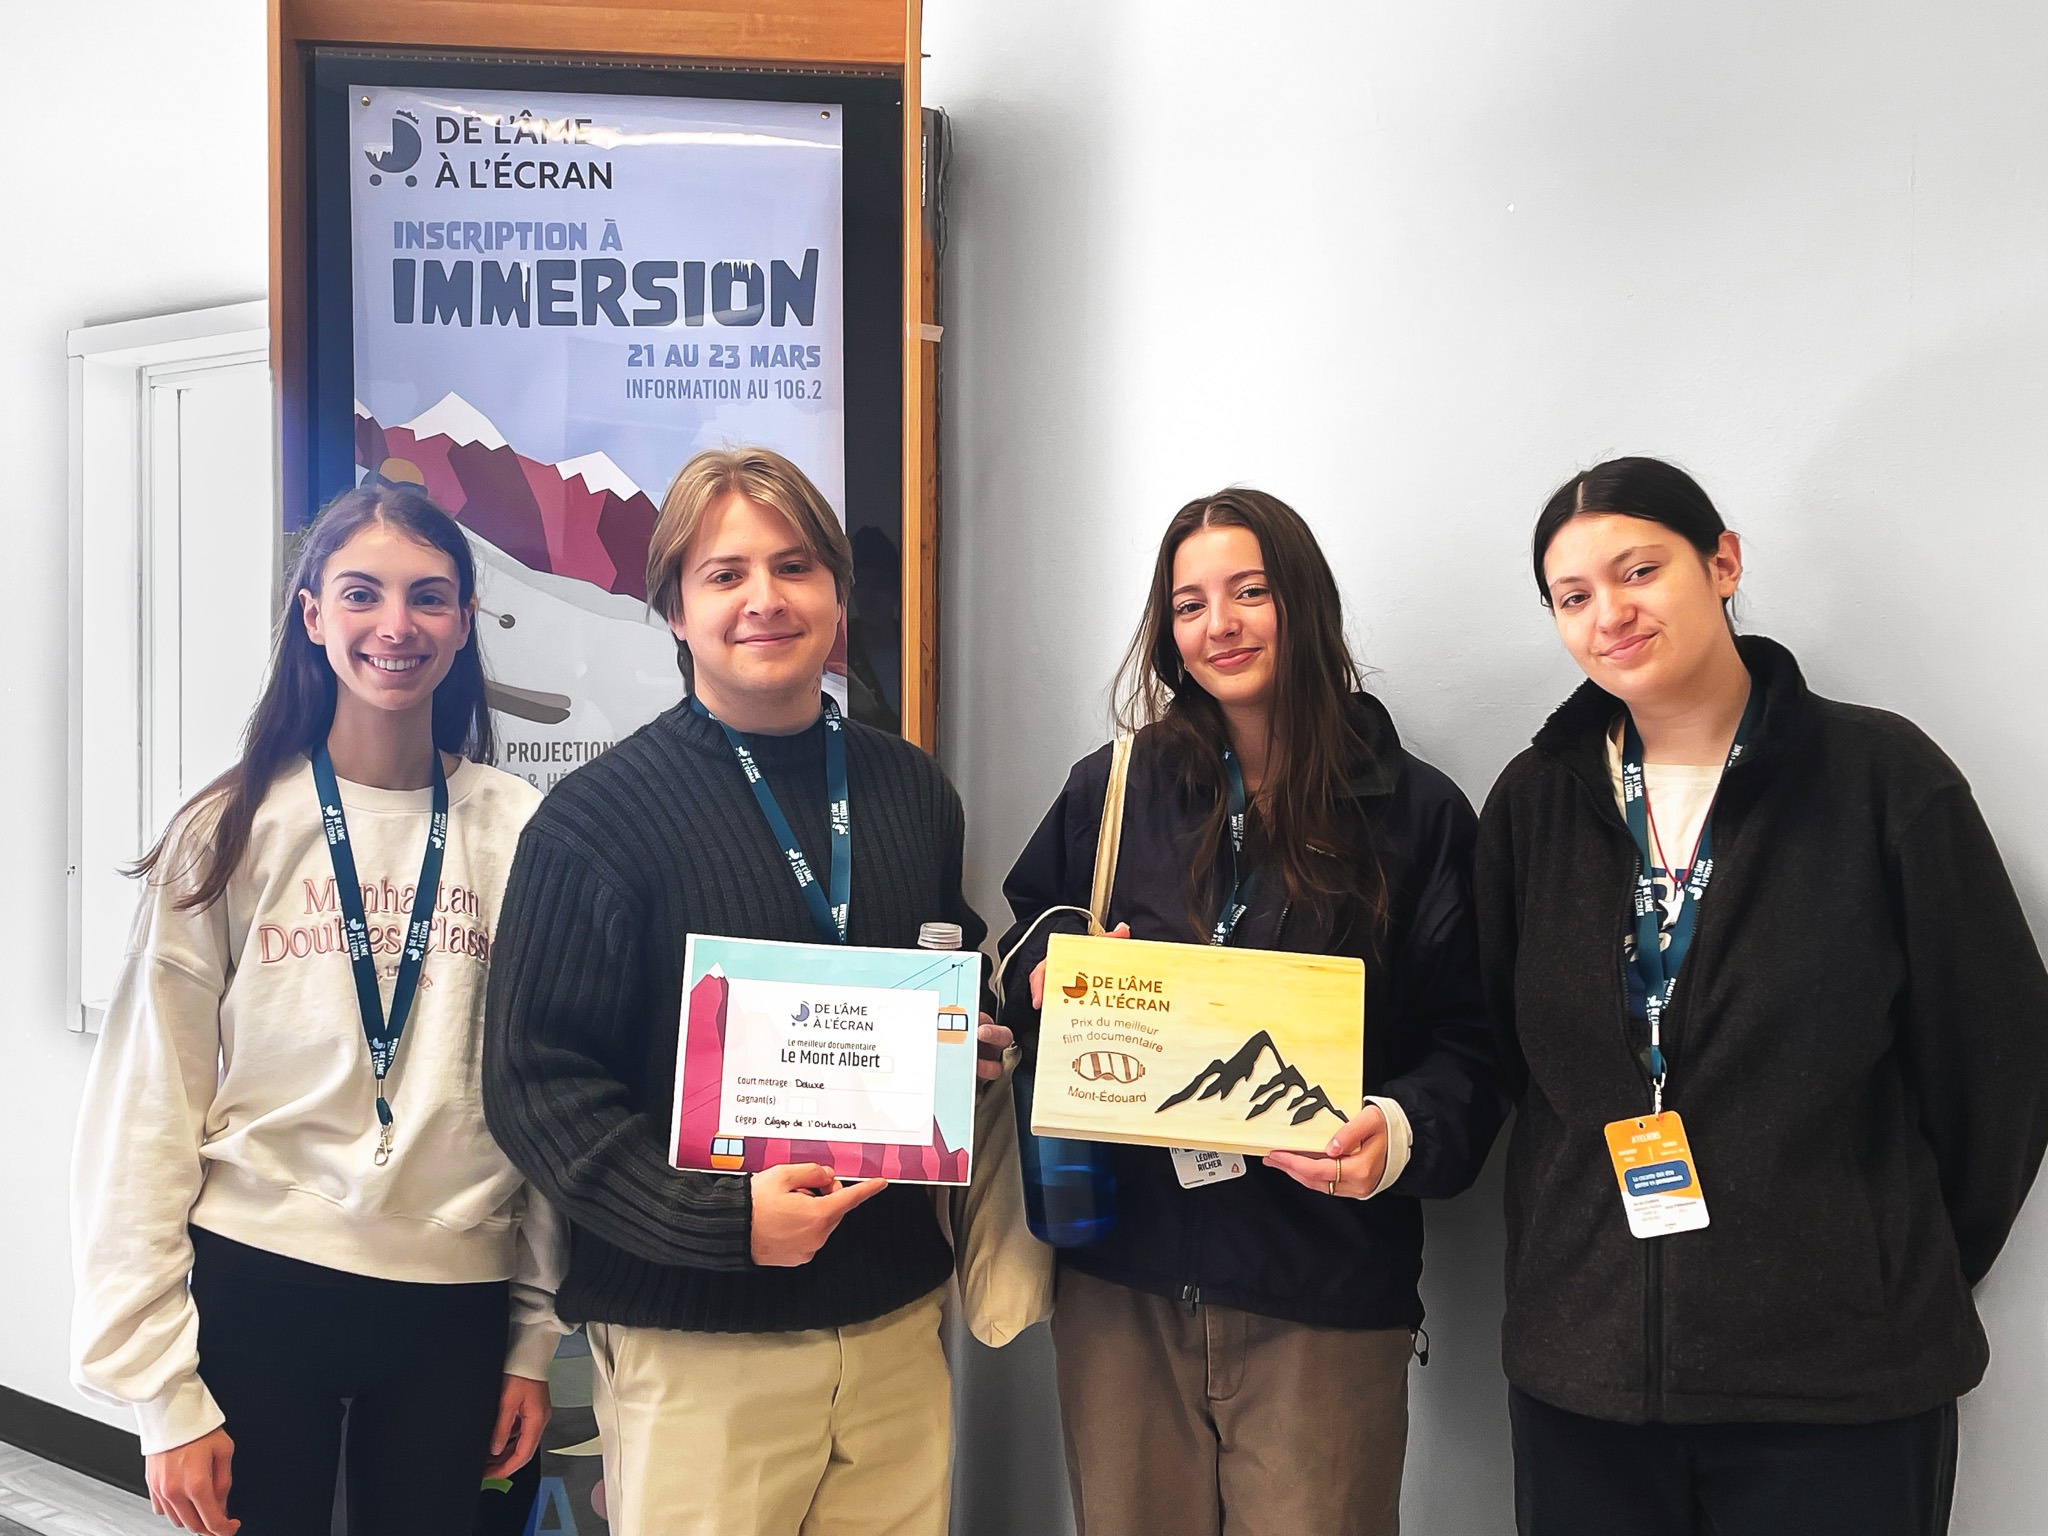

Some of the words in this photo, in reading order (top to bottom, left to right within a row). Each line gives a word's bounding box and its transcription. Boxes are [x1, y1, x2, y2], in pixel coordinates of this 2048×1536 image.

[435, 116, 482, 144] DE
[494, 109, 592, 145] L'ÂME
[434, 151, 460, 189] À
[470, 152, 613, 190] L'ÉCRAN
[393, 221, 587, 254] INSCRIPTION
[599, 218, 623, 251] À
[392, 248, 819, 328] IMMERSION
[627, 344, 655, 367] 21
[664, 344, 699, 367] AU
[708, 344, 740, 369] 23
[750, 344, 821, 370] MARS
[626, 378, 741, 399] INFORMATION
[747, 379, 768, 399] AU
[774, 379, 822, 399] 106.2
[303, 876, 480, 918] Mnhatan
[1092, 975, 1113, 989] DE
[1118, 975, 1163, 993] L'ÂME
[814, 1003, 831, 1014] DE
[834, 1002, 868, 1016] L'ÂME
[1090, 990, 1101, 1007] À
[1106, 993, 1170, 1013] L'ÉCRAN
[813, 1015, 822, 1028] À
[825, 1017, 874, 1031] L'ÉCRAN
[1071, 1018, 1093, 1029] Prix
[1096, 1016, 1111, 1027] du
[1114, 1019, 1160, 1036] meilleur
[787, 1039, 796, 1047] Le
[797, 1040, 826, 1048] meilleur
[827, 1041, 877, 1052] documentaire
[1062, 1032, 1083, 1045] film
[1086, 1030, 1164, 1053] documentaire
[781, 1048, 796, 1063] Le
[800, 1050, 835, 1066] Mont
[838, 1051, 880, 1068] Albert
[737, 1076, 757, 1085] Court
[758, 1078, 788, 1088] métrage
[736, 1094, 776, 1105] Gagnant(s)
[1068, 1085, 1147, 1103] Mont-Édouard
[793, 1119, 802, 1127] de
